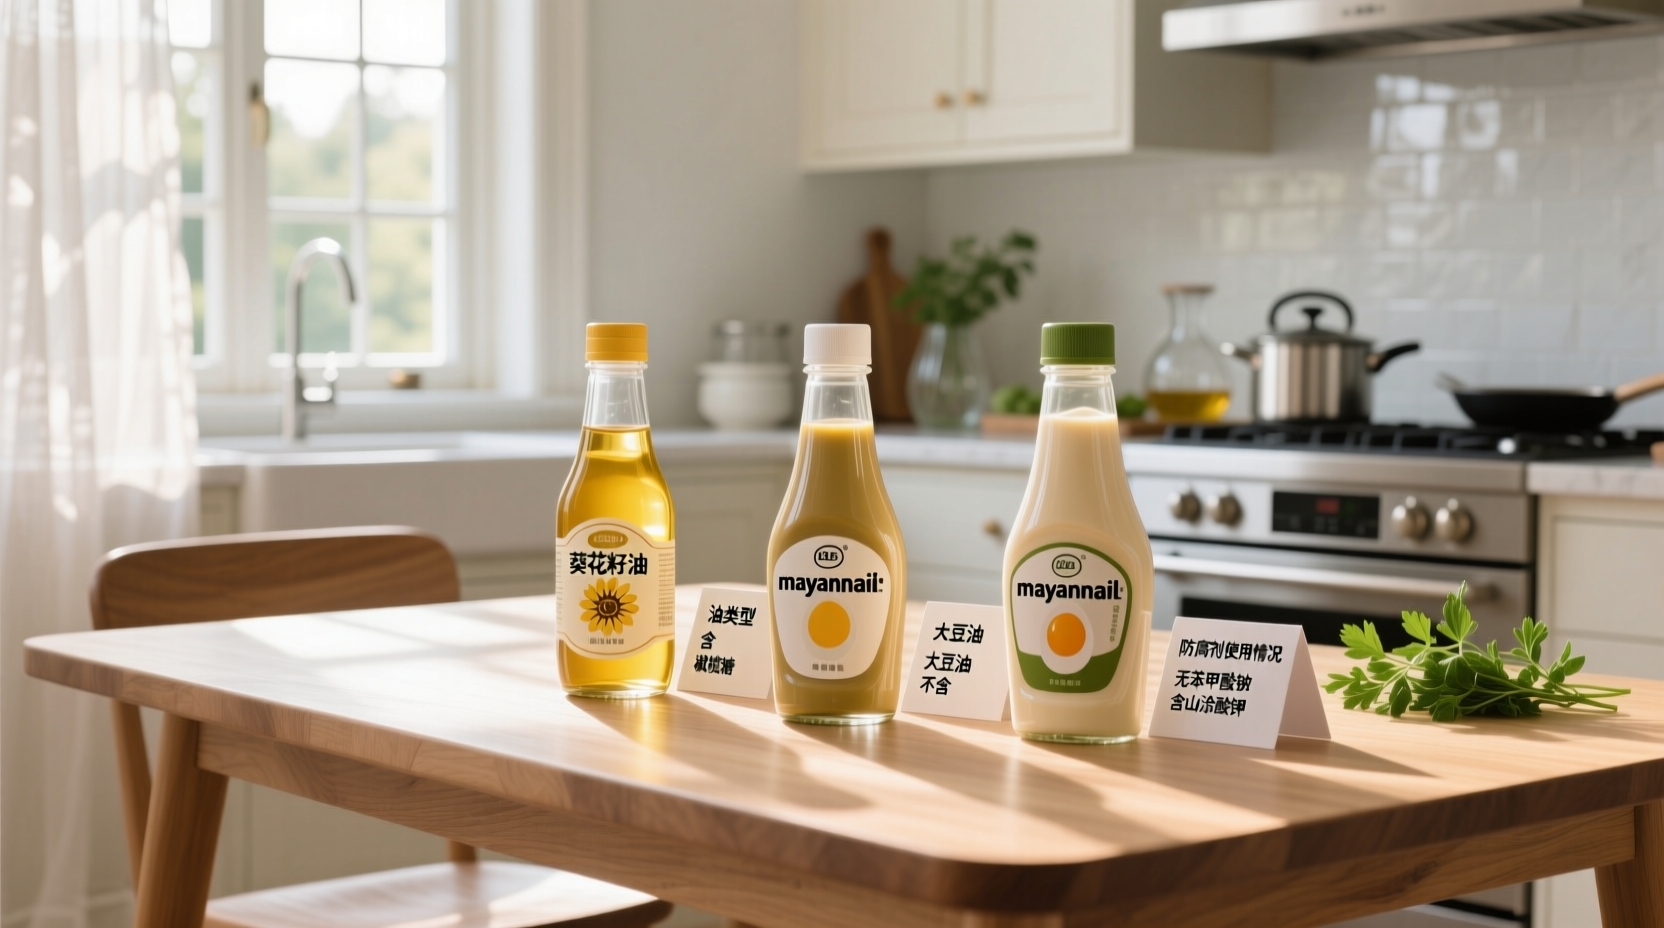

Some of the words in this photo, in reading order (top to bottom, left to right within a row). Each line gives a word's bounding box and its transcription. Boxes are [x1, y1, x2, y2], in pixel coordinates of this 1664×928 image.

[569, 551, 648, 575] 葵花籽油
[700, 631, 716, 650] 含
[932, 621, 984, 644] 大豆油
[923, 651, 972, 674] 大豆油
[920, 675, 952, 696] 不含
